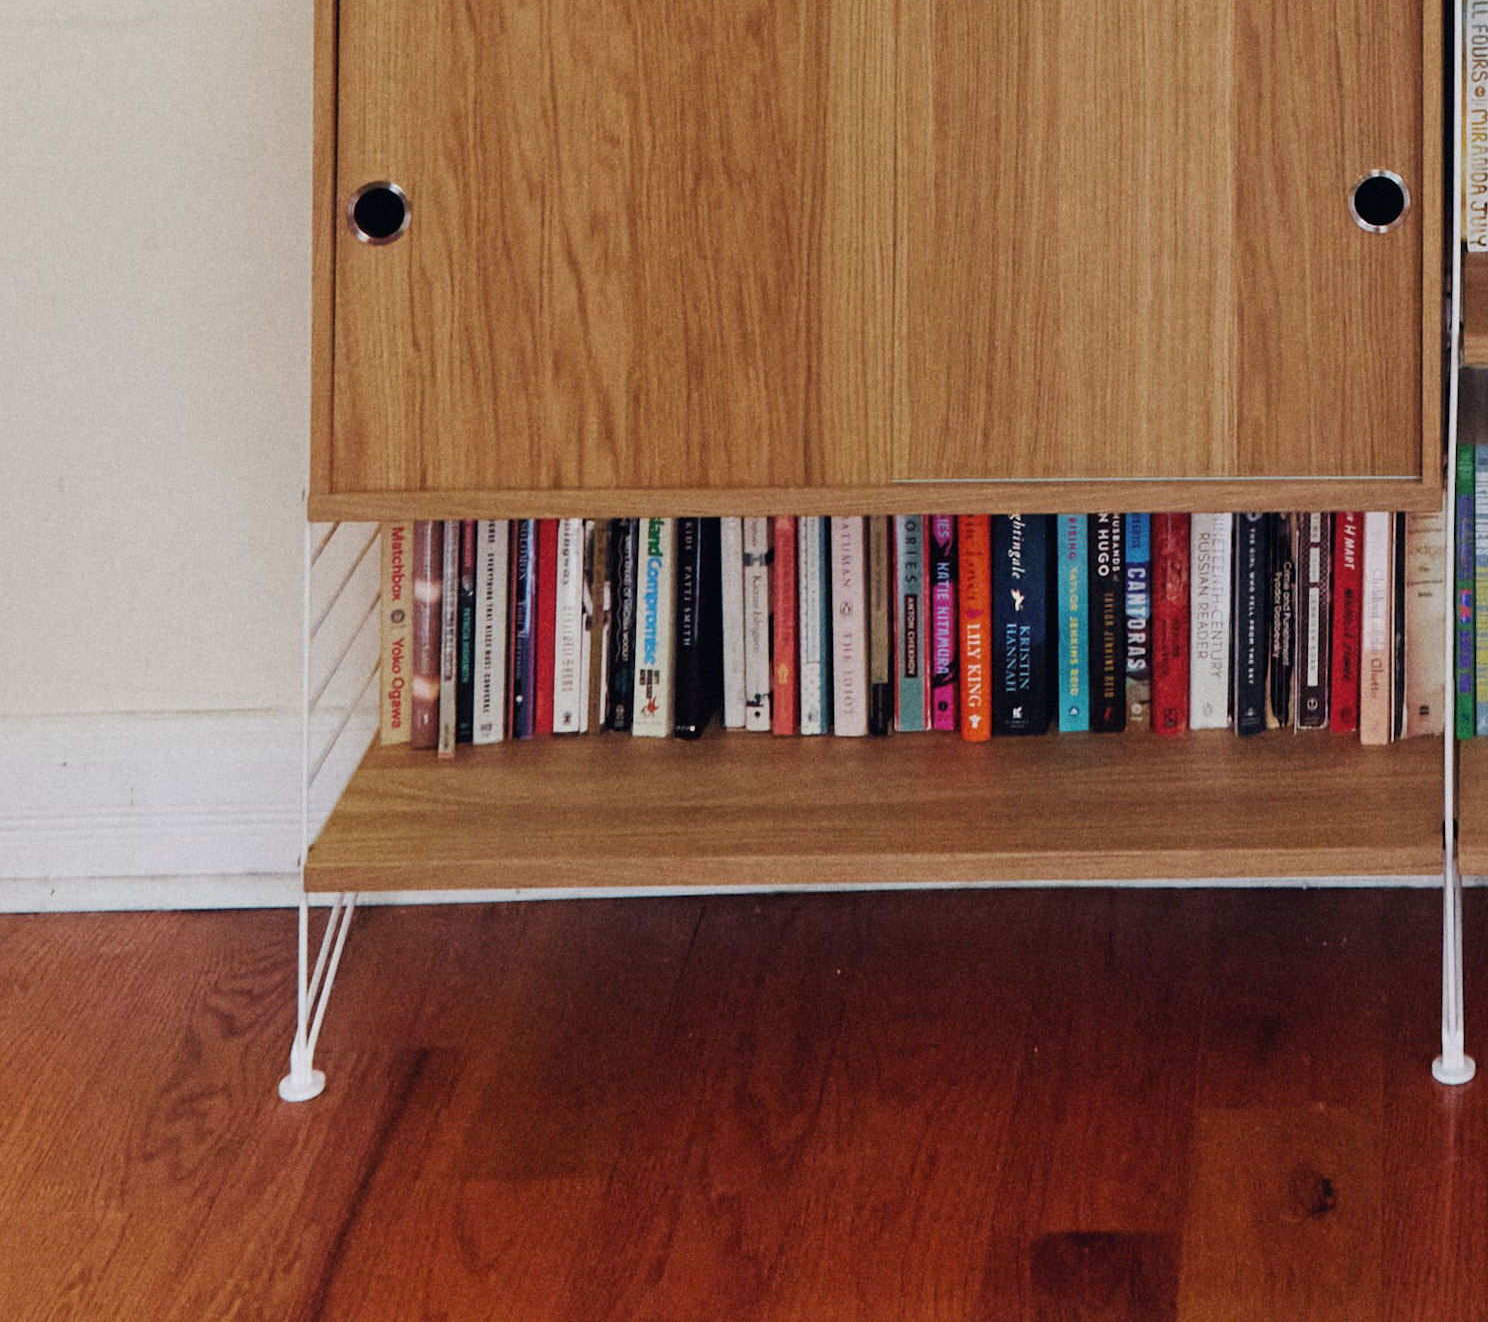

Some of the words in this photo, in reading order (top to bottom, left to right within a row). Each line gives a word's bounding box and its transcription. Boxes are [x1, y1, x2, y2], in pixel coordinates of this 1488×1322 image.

[391, 527, 405, 602] Matchbox
[1097, 529, 1110, 577] HUGO
[1198, 532, 1211, 596] RUSSIAN
[1248, 547, 1256, 568] GIRL
[683, 566, 693, 601] PATTI
[936, 562, 949, 600] KATIE
[644, 558, 662, 665] Compromise
[682, 607, 692, 646] SMITH
[907, 597, 915, 629] ANTON
[1127, 567, 1146, 671] CANTORAS
[1196, 602, 1209, 660] READER
[391, 637, 405, 674] Yoko
[907, 631, 916, 675] CHEKHOV
[936, 606, 950, 674] KITAMURA
[966, 623, 981, 659] LILY
[1005, 623, 1017, 692] HANNAH
[1019, 625, 1031, 690] KRISTIN
[1069, 616, 1079, 665] JENKINS
[1282, 612, 1291, 667] Punishment
[388, 677, 405, 729] Ogawa
[967, 664, 982, 708] KING
